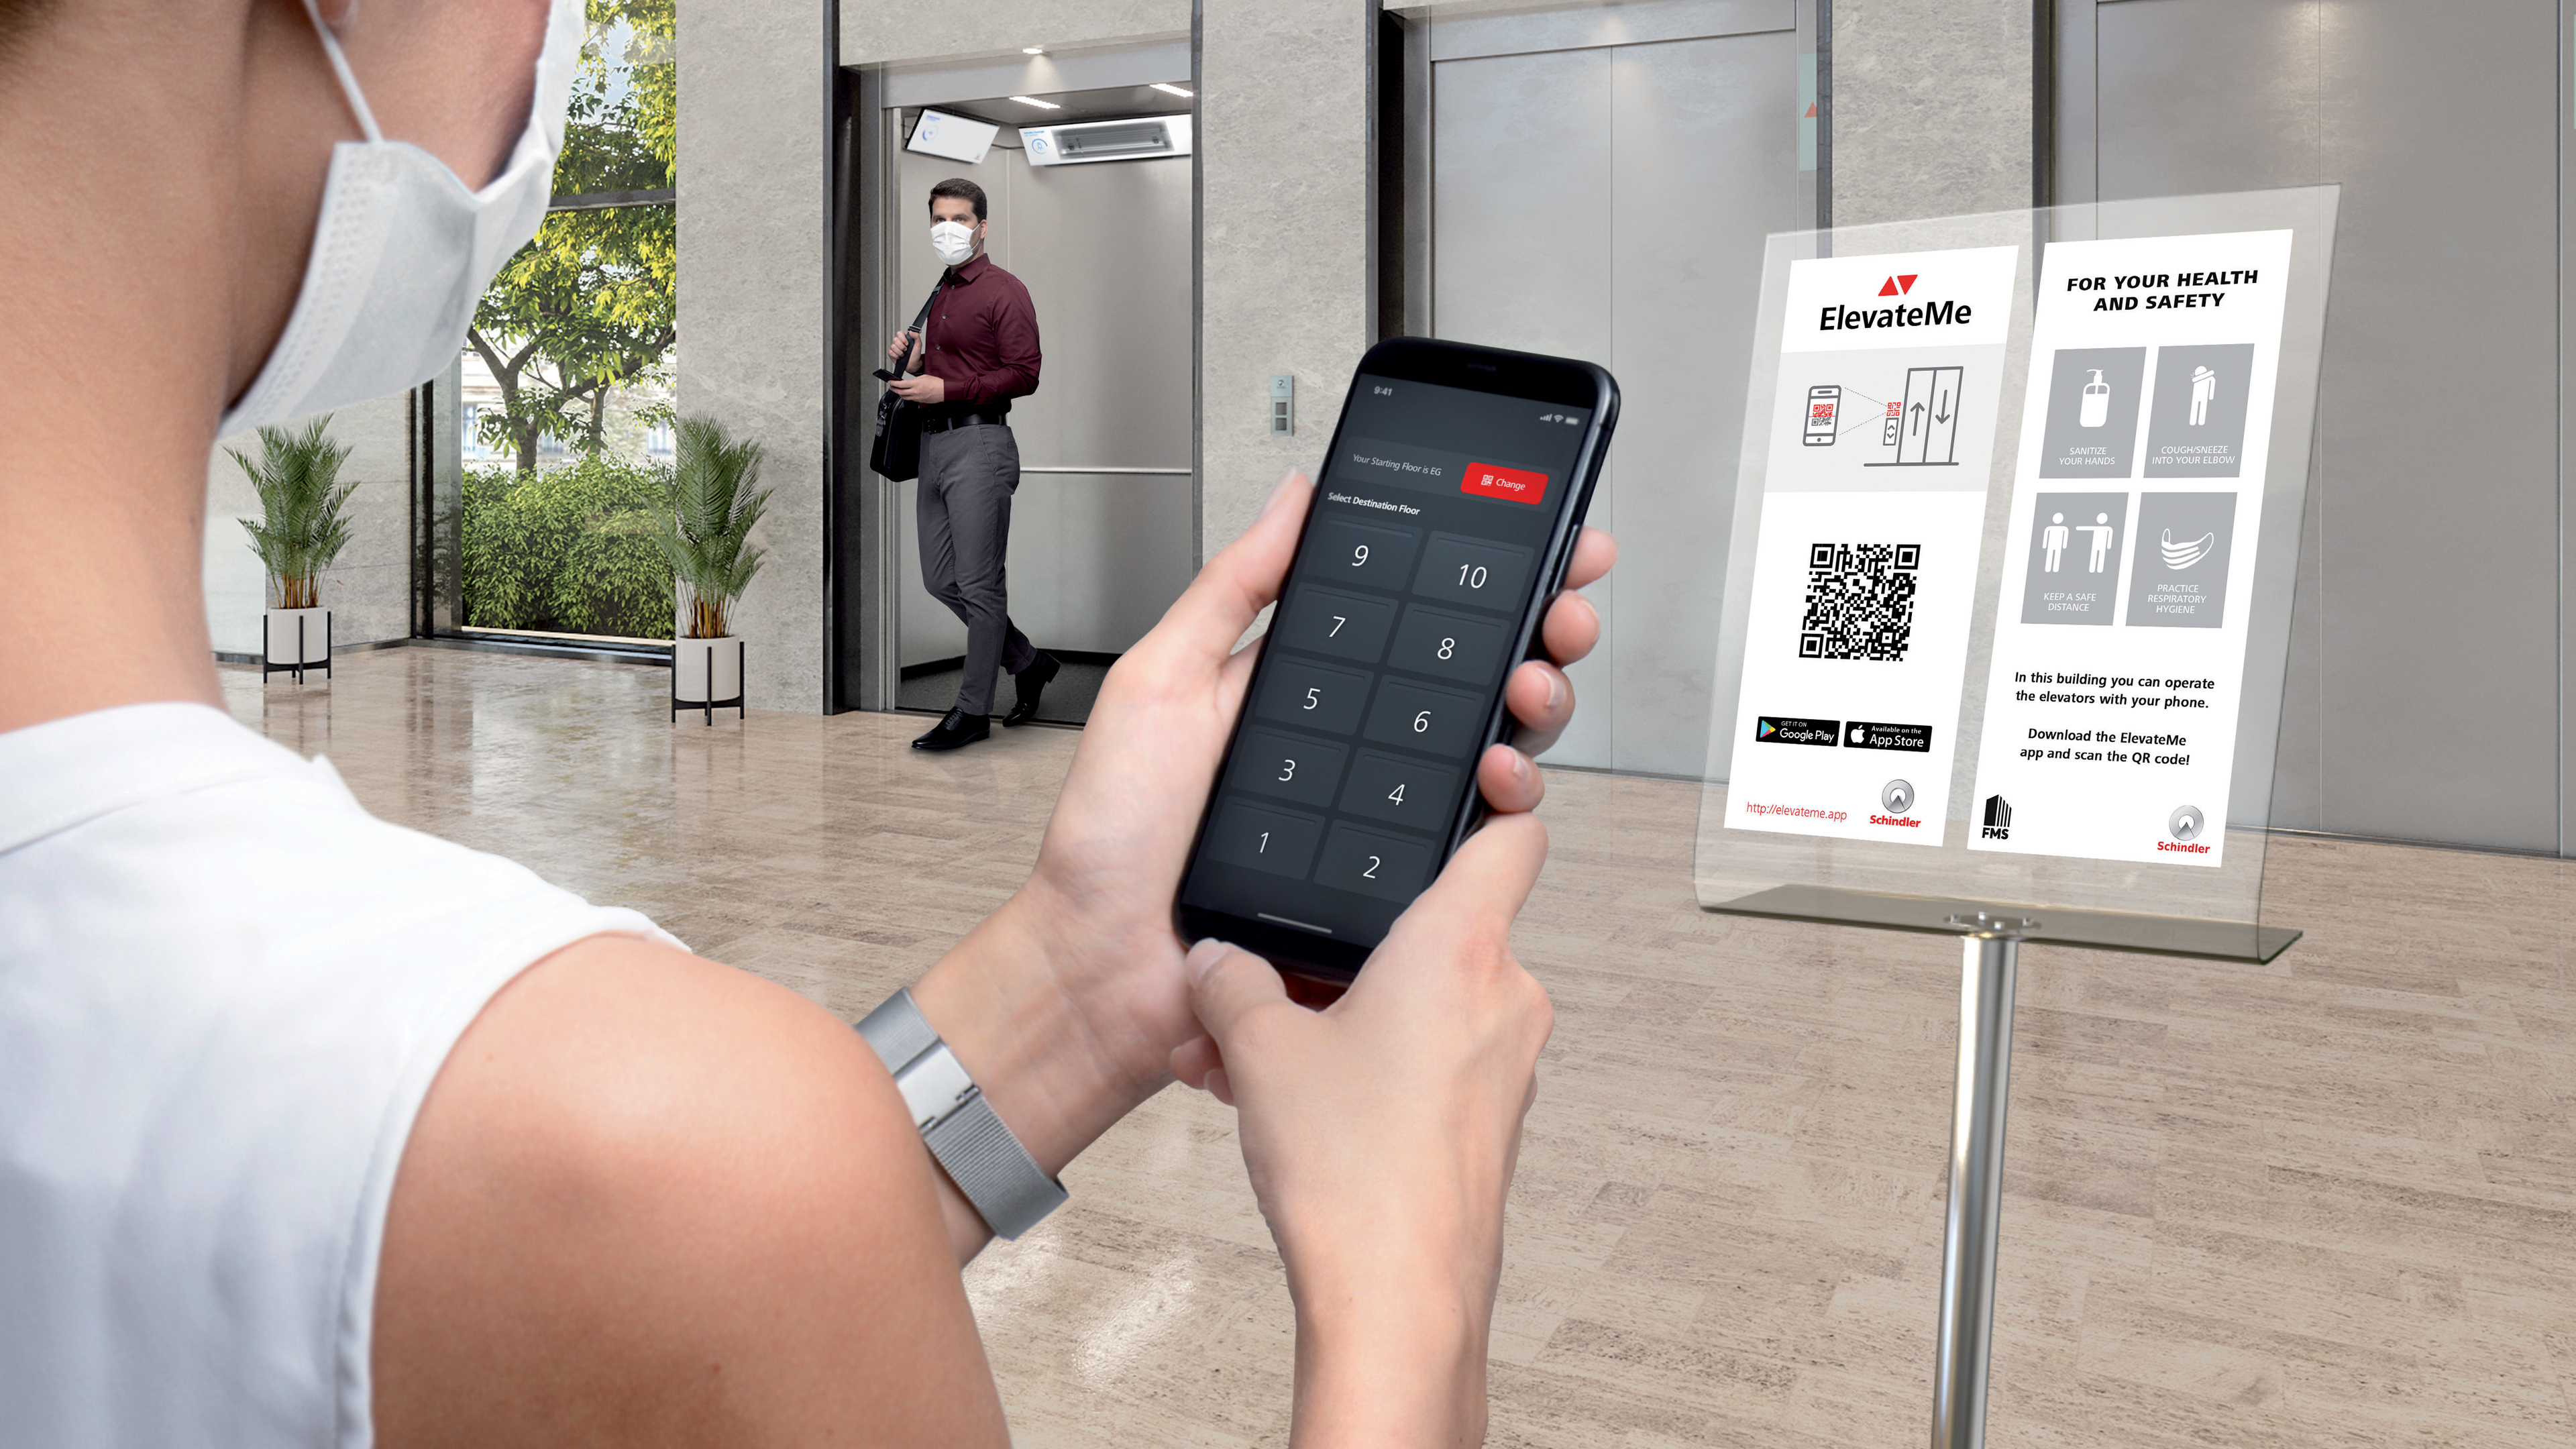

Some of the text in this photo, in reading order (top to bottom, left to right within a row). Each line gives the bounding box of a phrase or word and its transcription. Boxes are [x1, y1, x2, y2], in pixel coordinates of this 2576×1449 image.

[2067, 270, 2259, 292] FOR YOUR HEALTH
[2093, 292, 2225, 312] AND SAFETY
[1819, 300, 1972, 331] ElevateMe
[1373, 385, 1393, 396] 9:41
[2069, 447, 2107, 455] SANITIZE
[2161, 445, 2229, 454] COUGH/SNEEZE
[1353, 453, 1442, 476] Your Starting Floor is EG
[2059, 456, 2115, 465] YOUR HANDS
[2152, 455, 2235, 464] INTO YOUR ELBOW
[1495, 478, 1525, 492] Change
[1328, 492, 1421, 516] Select Destination Floor
[1351, 544, 1369, 567] 9
[1458, 564, 1487, 589] 10
[2043, 592, 2065, 601] KEEP
[2075, 593, 2096, 602] SAFE
[2157, 584, 2199, 592] PRACTICE
[2047, 603, 2090, 611] DISTANCE
[2147, 594, 2207, 604] RESPIRATORY
[2155, 605, 2195, 614] HYGIENE
[1328, 616, 1346, 637] 7
[1437, 637, 1455, 660] 8
[2015, 672, 2214, 690] In this building you can operate
[1303, 688, 1321, 710] 5
[2016, 690, 2209, 709] the elevators with your phone.
[1413, 710, 1432, 733] 6
[1871, 725, 1900, 734] Available
[1779, 728, 1835, 744] Google Play
[1869, 734, 1924, 748] App Store
[2028, 728, 2186, 746] Download the ElevateMe
[2020, 748, 2190, 765] app and scan the QR code!
[1278, 759, 1296, 782] 3
[1388, 784, 1405, 806] 4
[1746, 802, 1847, 822] http://elevateme.app
[1870, 815, 1921, 828] Schindler
[1258, 832, 1270, 853] 1
[1982, 827, 2009, 840] FMS
[2157, 841, 2210, 854] Schindler
[1363, 855, 1381, 879] 2
